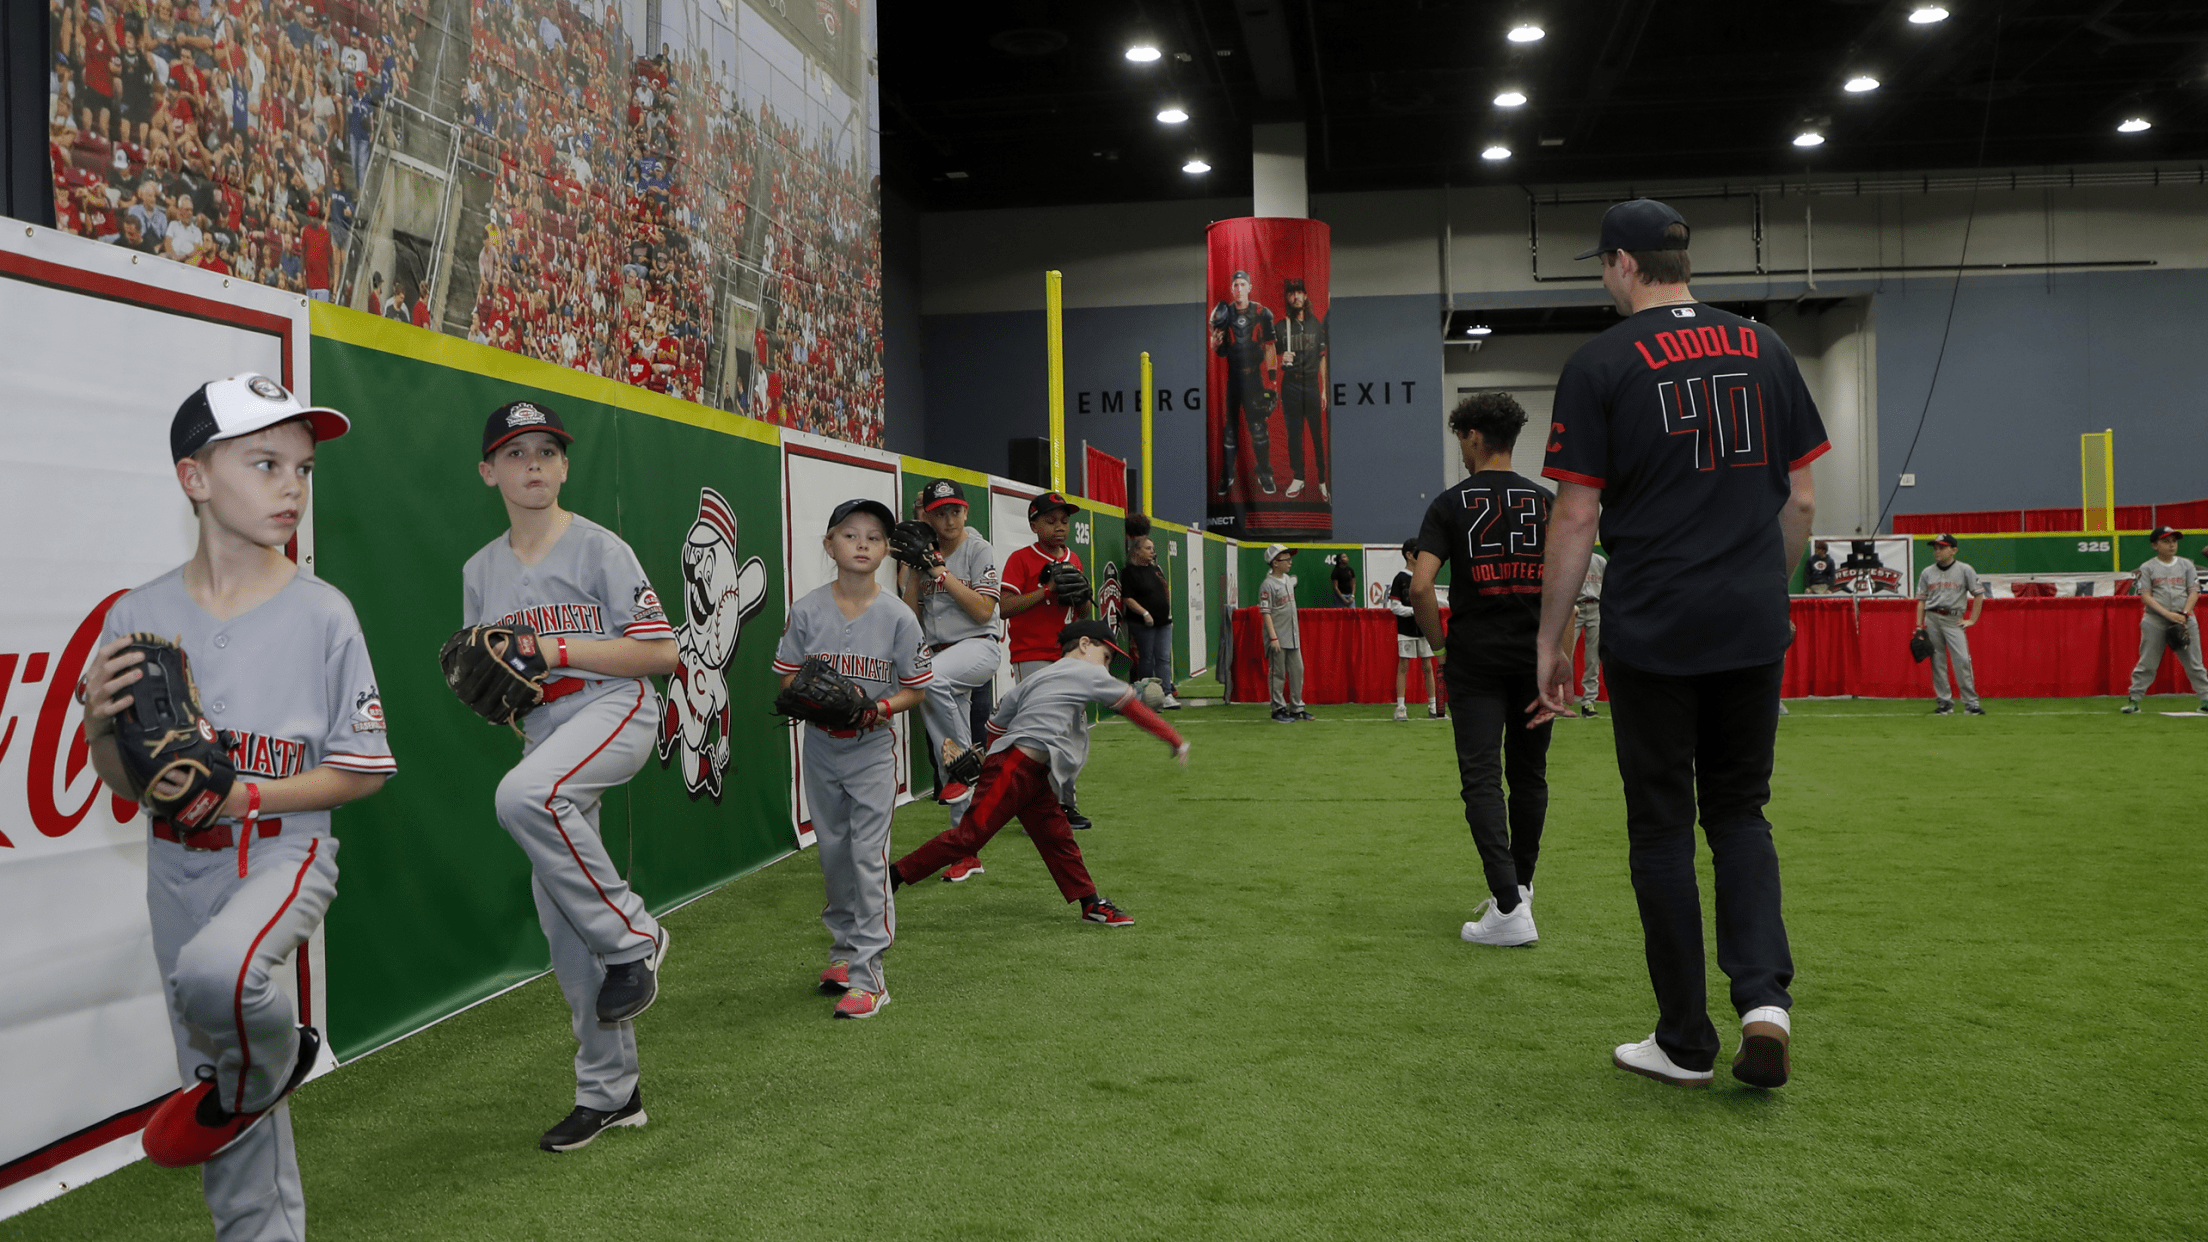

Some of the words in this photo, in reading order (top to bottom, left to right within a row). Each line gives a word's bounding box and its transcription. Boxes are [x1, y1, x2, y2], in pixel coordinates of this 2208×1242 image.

[1634, 324, 1759, 370] LODOLO
[1333, 381, 1417, 406] EXIT
[1657, 372, 1768, 472] 40
[1074, 521, 1090, 545] 325
[1461, 488, 1548, 559] 23
[2077, 541, 2111, 553] 325
